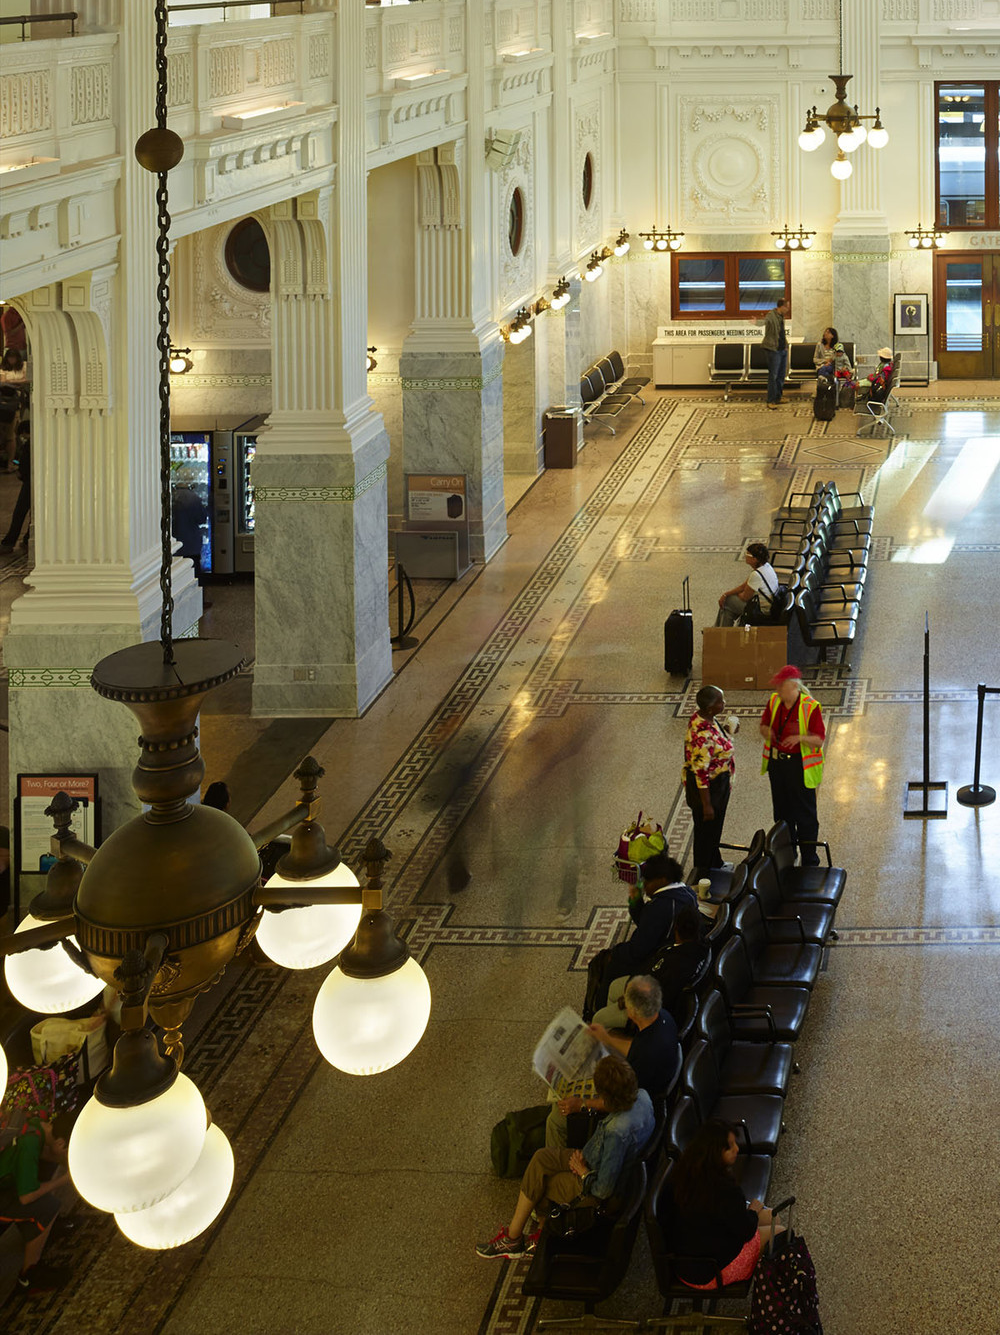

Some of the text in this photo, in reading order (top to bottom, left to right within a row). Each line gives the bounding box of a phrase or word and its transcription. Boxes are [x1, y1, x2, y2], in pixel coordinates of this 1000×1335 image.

[430, 477, 463, 488] Carry On
[26, 780, 42, 788] Two,
